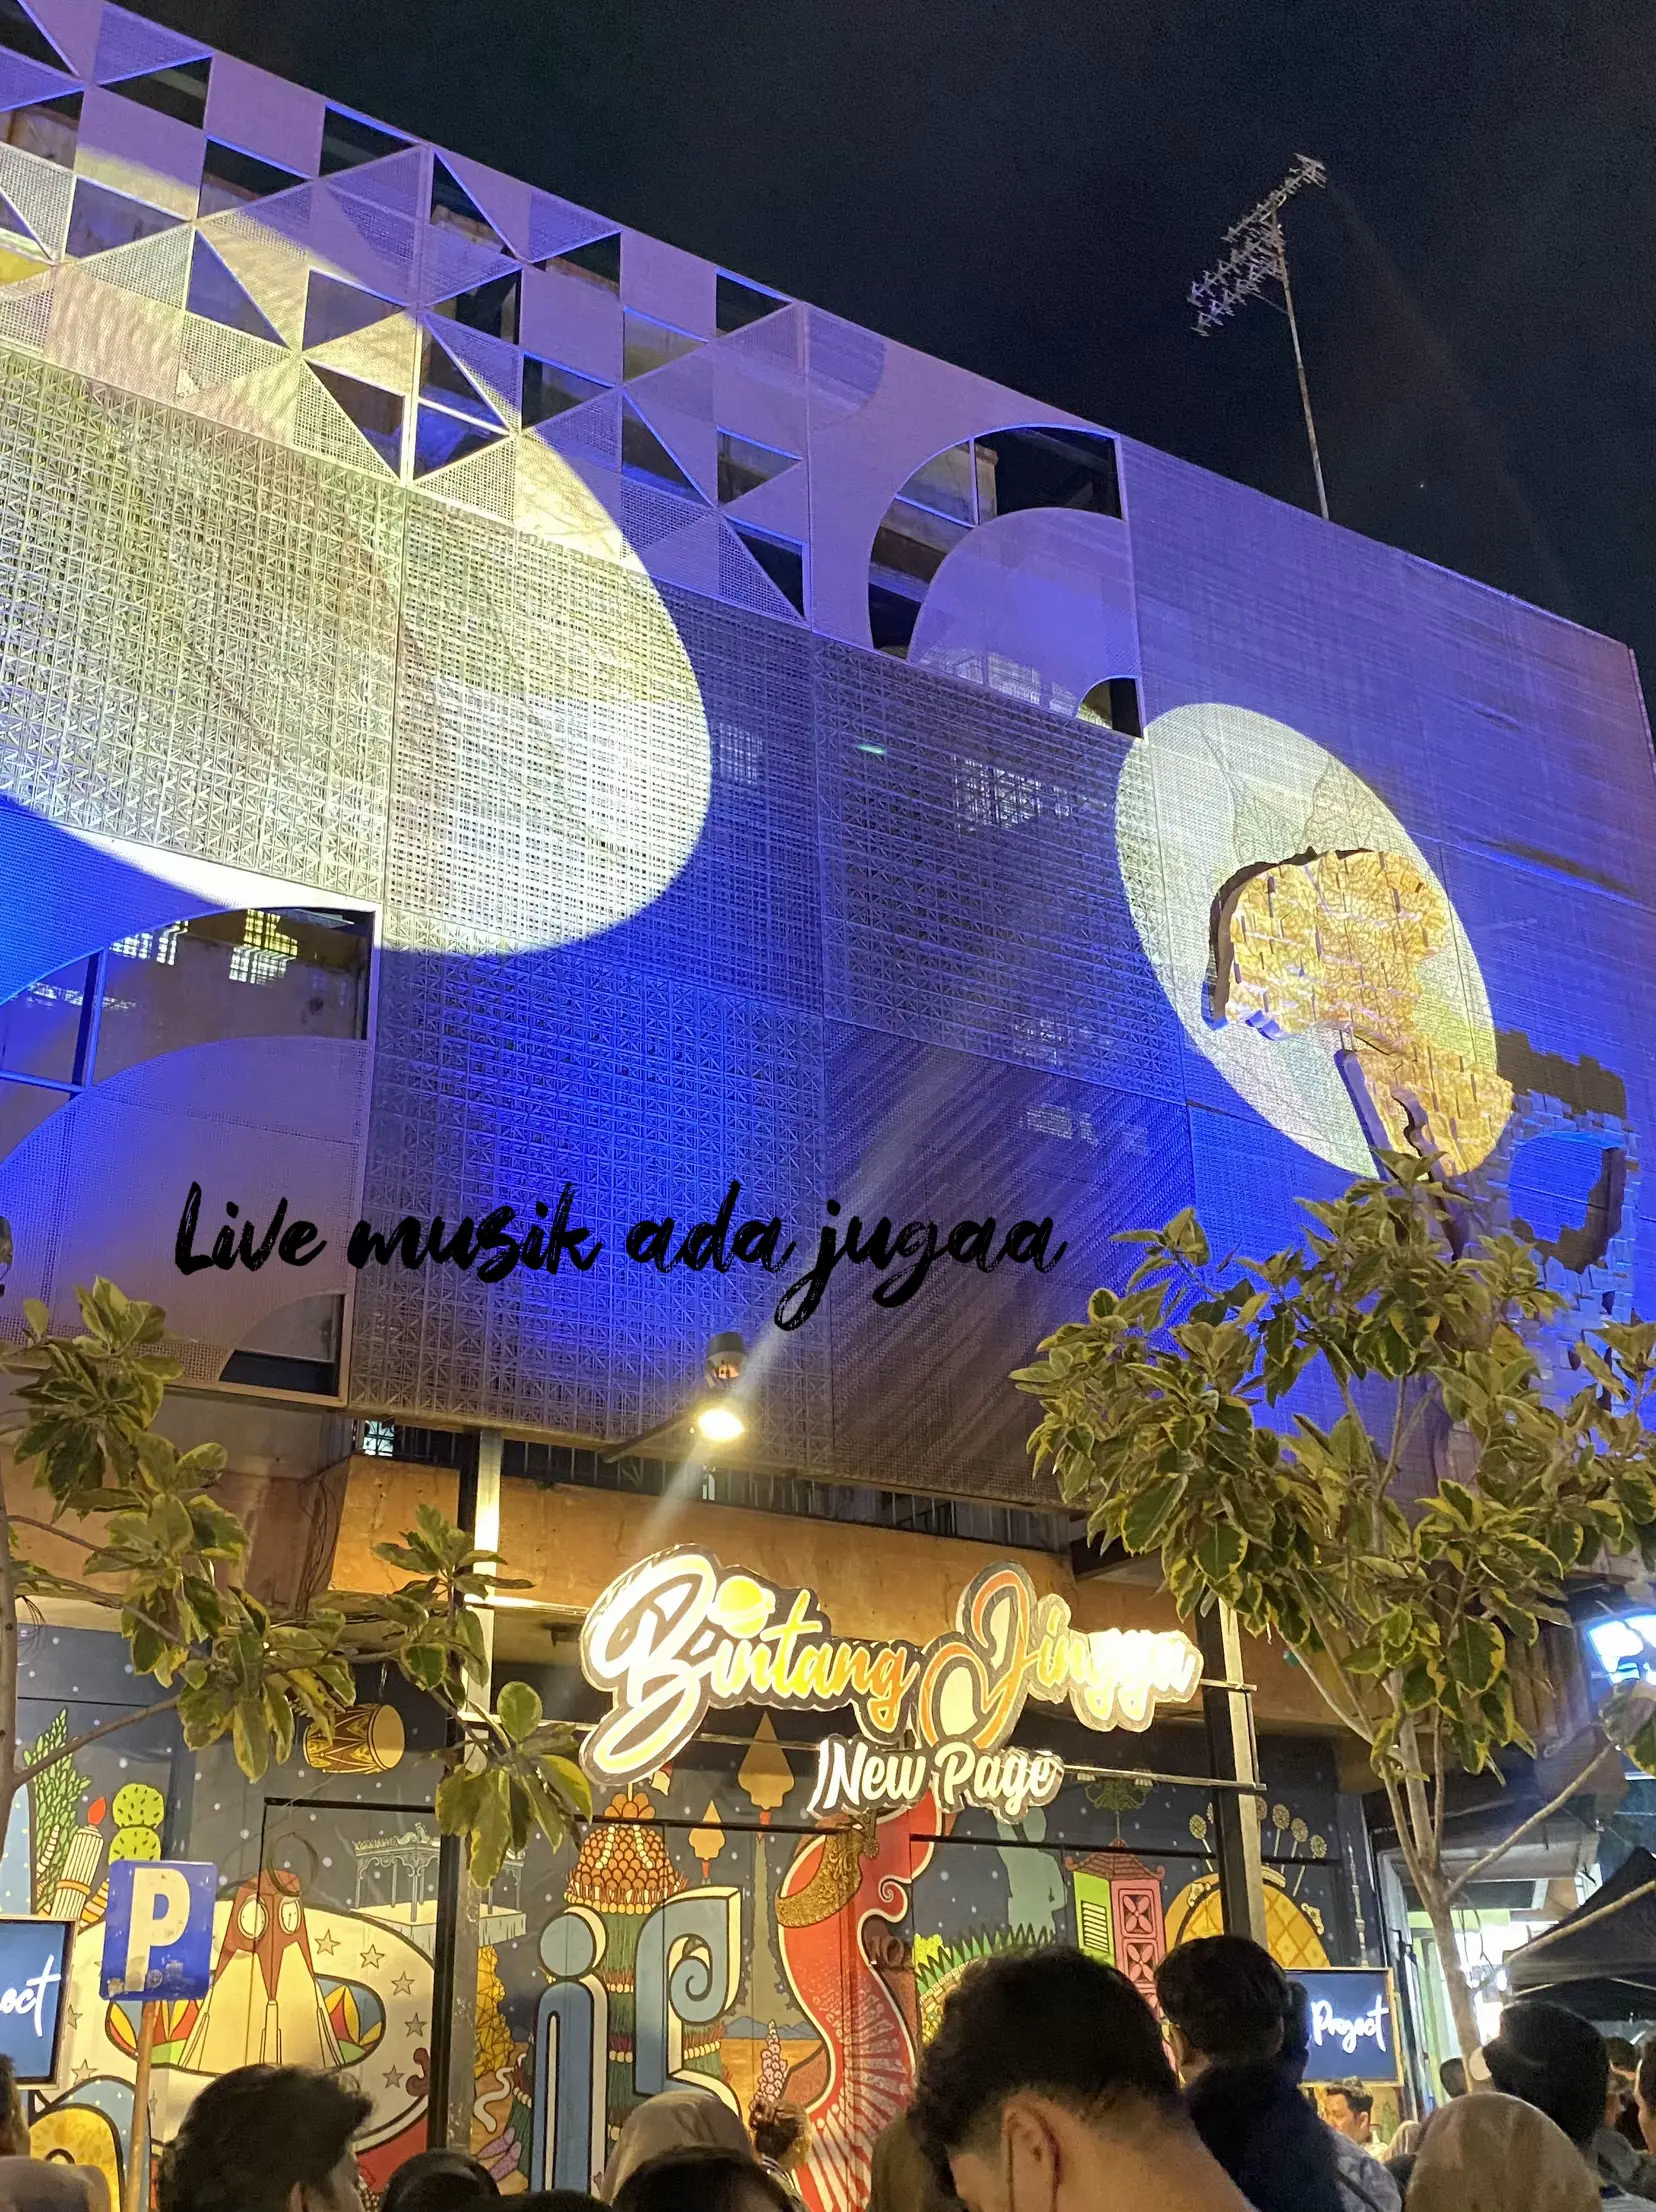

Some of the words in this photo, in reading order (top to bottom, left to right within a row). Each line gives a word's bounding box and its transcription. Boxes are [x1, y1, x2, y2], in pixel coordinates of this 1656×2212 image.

[588, 1553, 920, 1774] Bintang
[808, 1738, 927, 1810] New
[934, 1742, 1060, 1815] Page
[123, 1867, 191, 1992] P
